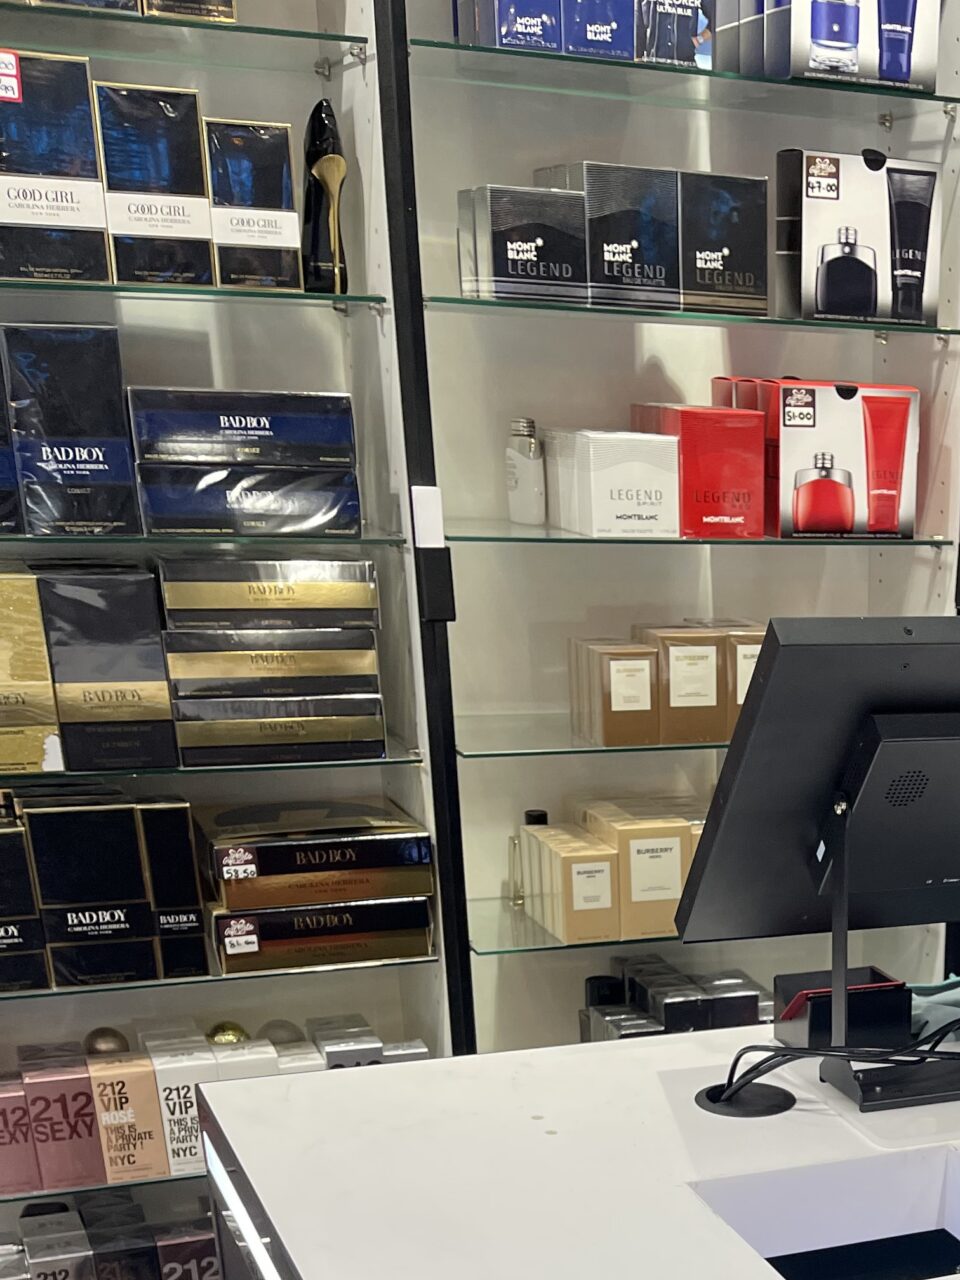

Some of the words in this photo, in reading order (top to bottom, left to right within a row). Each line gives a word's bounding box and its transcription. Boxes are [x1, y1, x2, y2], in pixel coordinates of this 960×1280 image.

[656, 4, 677, 14] ULTRA
[677, 7, 692, 17] BLUE
[517, 16, 542, 27] MONT
[516, 24, 542, 34] BLANC
[587, 24, 610, 34] MONT
[587, 32, 612, 42] BLANC
[7, 187, 42, 201] GOOD
[45, 190, 80, 204] GIRL
[46, 204, 80, 212] HERRERA
[127, 203, 158, 215] GOOD
[161, 205, 190, 217] GIRL
[230, 217, 255, 228] GOOD
[257, 218, 282, 229] GIRL
[506, 240, 536, 251] MONT
[603, 243, 631, 254] MONT
[507, 250, 537, 261] BLANC
[603, 252, 633, 263] BLANC
[695, 251, 722, 261] MONT
[507, 260, 572, 278] LEGEND
[603, 261, 666, 279] LEGEND
[696, 258, 724, 270] BLANC
[696, 269, 755, 286] LEGEND
[220, 415, 246, 428] BAD
[247, 416, 271, 429] BOY
[41, 447, 73, 461] BAD
[75, 447, 106, 461] BOY
[610, 489, 663, 501] LEGEND
[695, 490, 751, 504] LEGEND
[616, 513, 658, 521] MONTBLANC
[703, 516, 744, 524] MONTBLANC
[83, 690, 111, 703] BAD
[112, 688, 143, 701] BOY
[296, 851, 327, 865] BAD
[329, 848, 359, 862] BOY
[636, 847, 674, 855] BURBERRY
[67, 911, 97, 926] BAD
[99, 909, 127, 923] BOY
[160, 914, 179, 924] BAD
[179, 913, 197, 923] BOY
[294, 916, 325, 930] BAD
[326, 912, 354, 926] BOY
[97, 1081, 127, 1097] 212
[163, 1085, 192, 1101] 212
[30, 1091, 94, 1122] 212
[101, 1096, 129, 1112] VIP
[166, 1100, 194, 1116] VIP
[101, 1108, 135, 1125] ROSÉ
[168, 1118, 189, 1128] THIS
[191, 1116, 199, 1125] IS
[0, 1126, 29, 1146] EXY
[34, 1118, 94, 1143] SEXY
[104, 1125, 125, 1135] THIS
[128, 1124, 137, 1133] IS
[115, 1131, 154, 1143] PRIVATE
[170, 1135, 199, 1145] PARTY
[107, 1141, 137, 1152] PARTY
[172, 1146, 198, 1159] NYC
[109, 1154, 136, 1167] NYC
